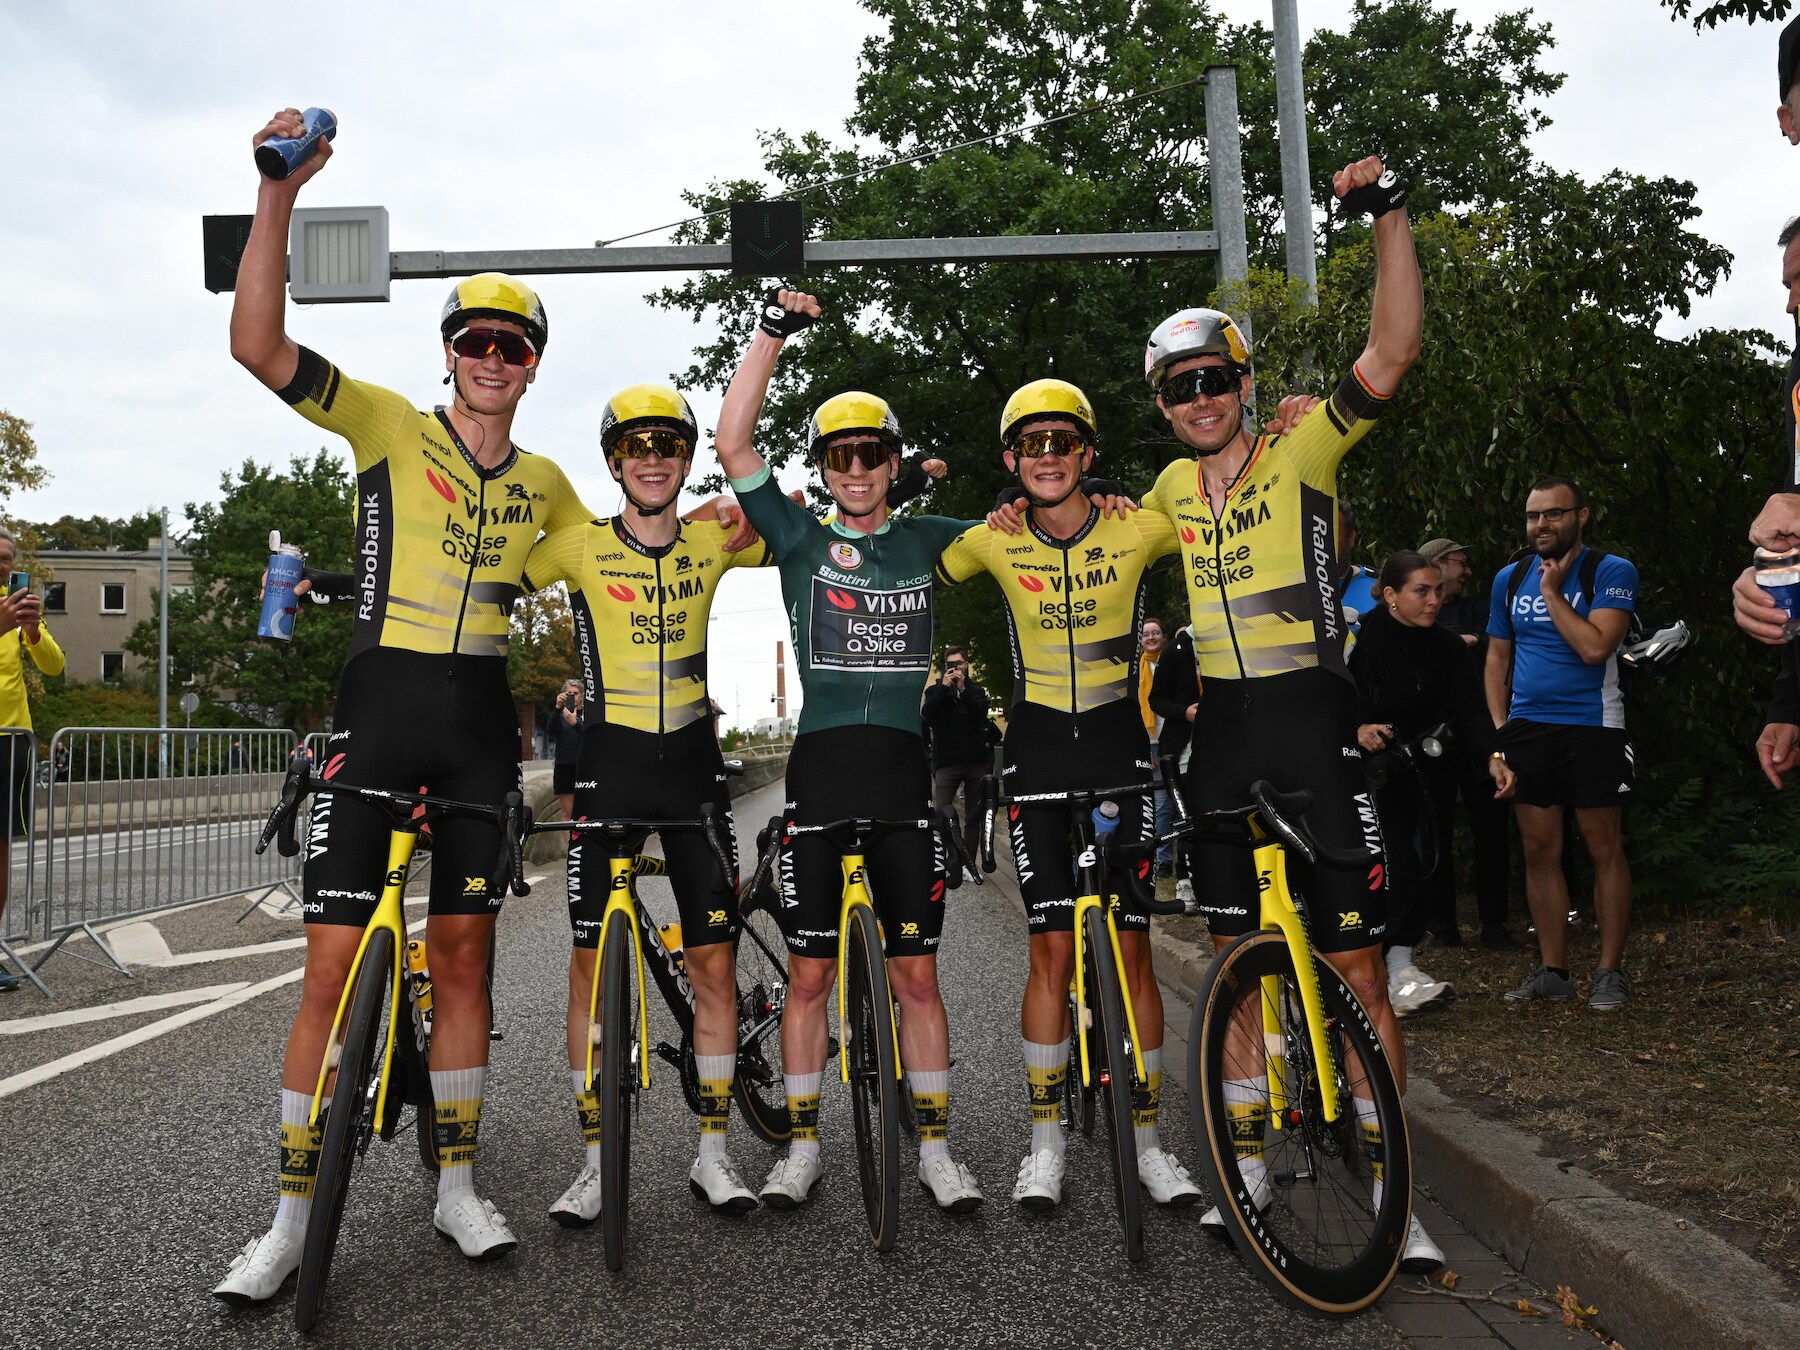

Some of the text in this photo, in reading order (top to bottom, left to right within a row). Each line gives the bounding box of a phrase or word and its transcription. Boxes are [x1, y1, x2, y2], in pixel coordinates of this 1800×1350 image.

[1170, 328, 1185, 337] Red
[421, 432, 452, 457] nimbl
[456, 441, 475, 468] VISMA
[422, 449, 477, 498] cervélo
[464, 495, 533, 527] VISMA
[1175, 495, 1194, 507] nimbl
[1177, 513, 1212, 525] cervélo
[1201, 500, 1272, 546] VISMA
[445, 513, 507, 549] lease
[1035, 529, 1051, 544] VISMA
[358, 492, 379, 621] Rabobank
[596, 552, 626, 562] nimbl
[626, 538, 646, 554] VISMA
[1005, 545, 1035, 555] nimbl
[1012, 562, 1061, 572] cervélo
[1192, 545, 1250, 570] lease
[270, 567, 298, 578] AMACX
[600, 569, 654, 580] cervélo
[818, 565, 872, 587] Santini
[1050, 565, 1118, 593] VISMA
[1312, 514, 1339, 640] Rabobank
[267, 587, 286, 595] JUICE
[268, 580, 295, 589] CHERRY
[642, 577, 704, 605] VISMA
[863, 591, 927, 614] VISMA
[1039, 599, 1097, 616] lease
[630, 611, 687, 628] lease
[847, 618, 908, 636] lease
[575, 609, 595, 702] Rabobank
[1353, 792, 1382, 855] VISMA
[1013, 823, 1034, 884] VISMA
[567, 845, 583, 903] VISMA
[781, 851, 799, 908] VISMA
[317, 889, 376, 901] cervélo
[1200, 904, 1247, 915] cervélo
[797, 929, 839, 938] cervélo
[1338, 983, 1381, 1052] RESERVE
[1237, 1190, 1287, 1269] RESERVE
